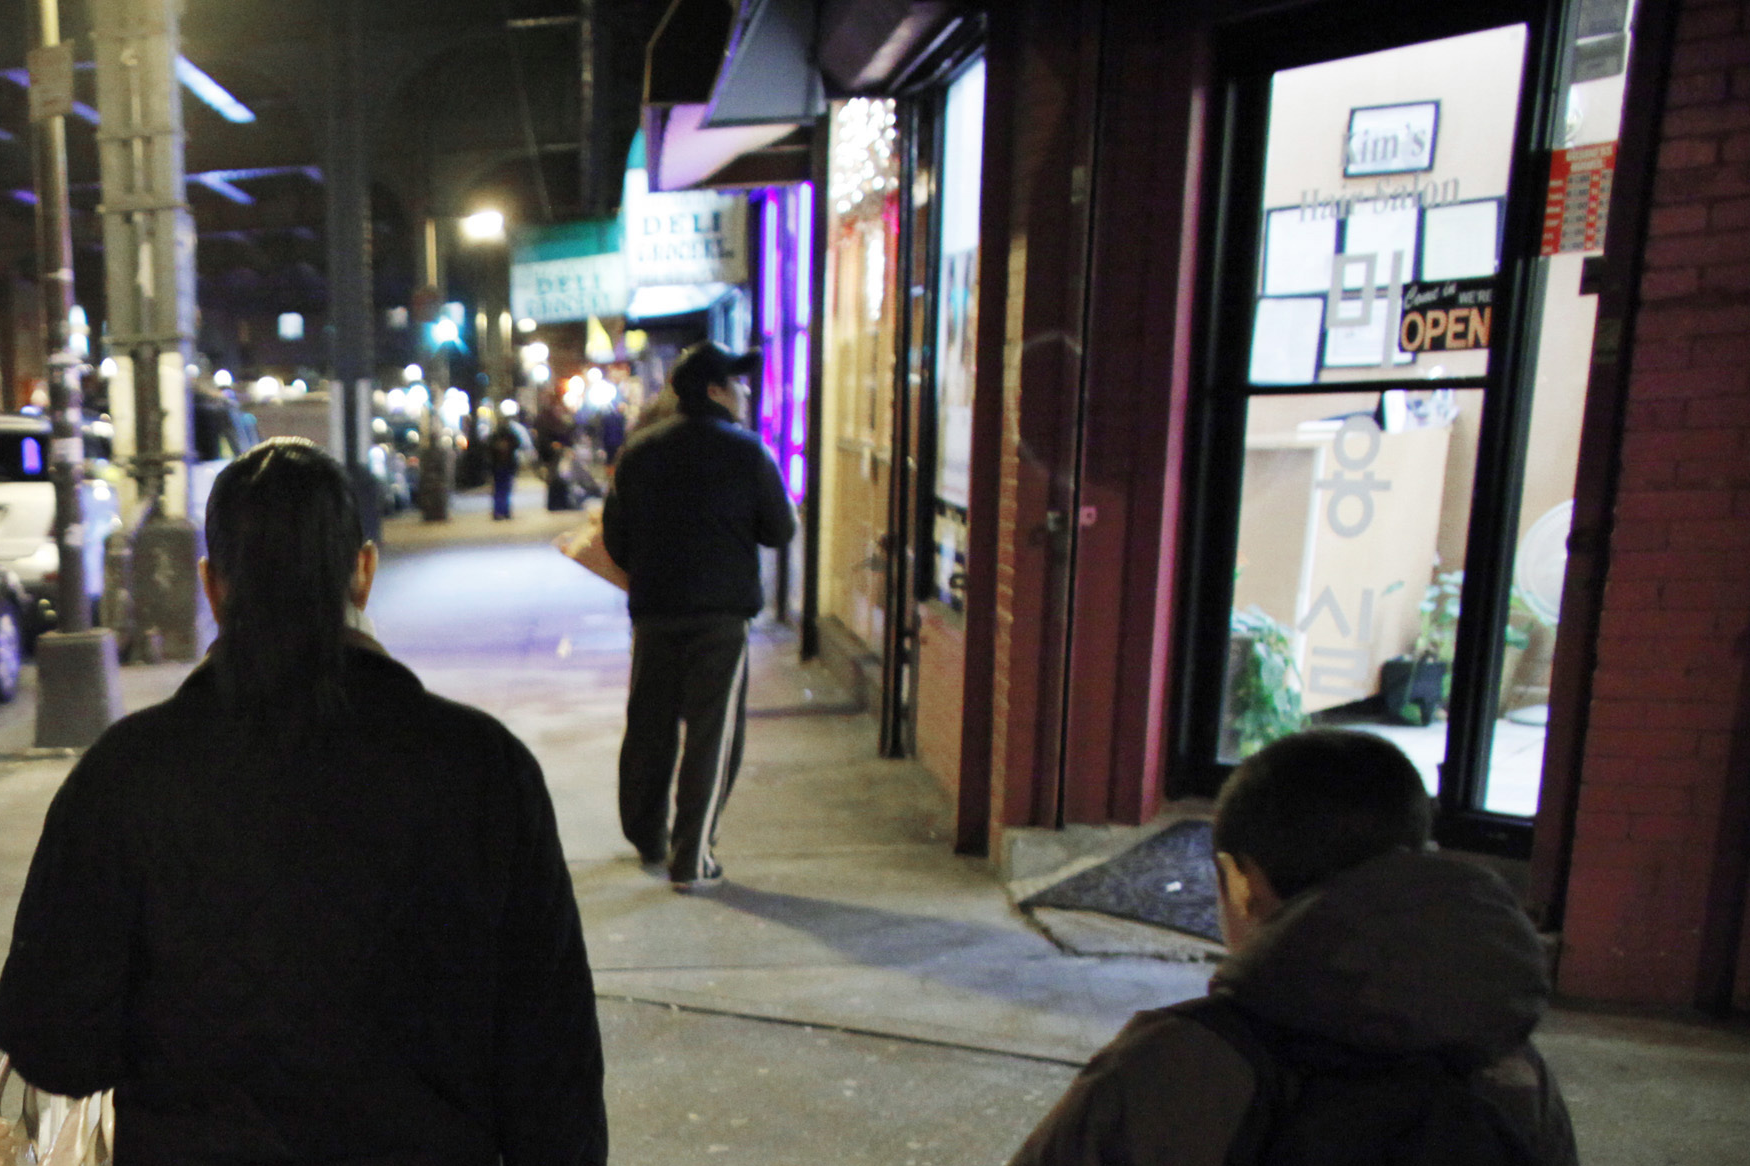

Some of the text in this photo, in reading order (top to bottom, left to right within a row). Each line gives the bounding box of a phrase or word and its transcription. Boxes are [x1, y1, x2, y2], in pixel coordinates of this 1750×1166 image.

[1340, 122, 1426, 168] Kim's
[1299, 172, 1461, 223] Hair Salon
[643, 211, 722, 236] DELI
[1401, 306, 1492, 353] OPEN
[1297, 249, 1405, 698] 미용실
